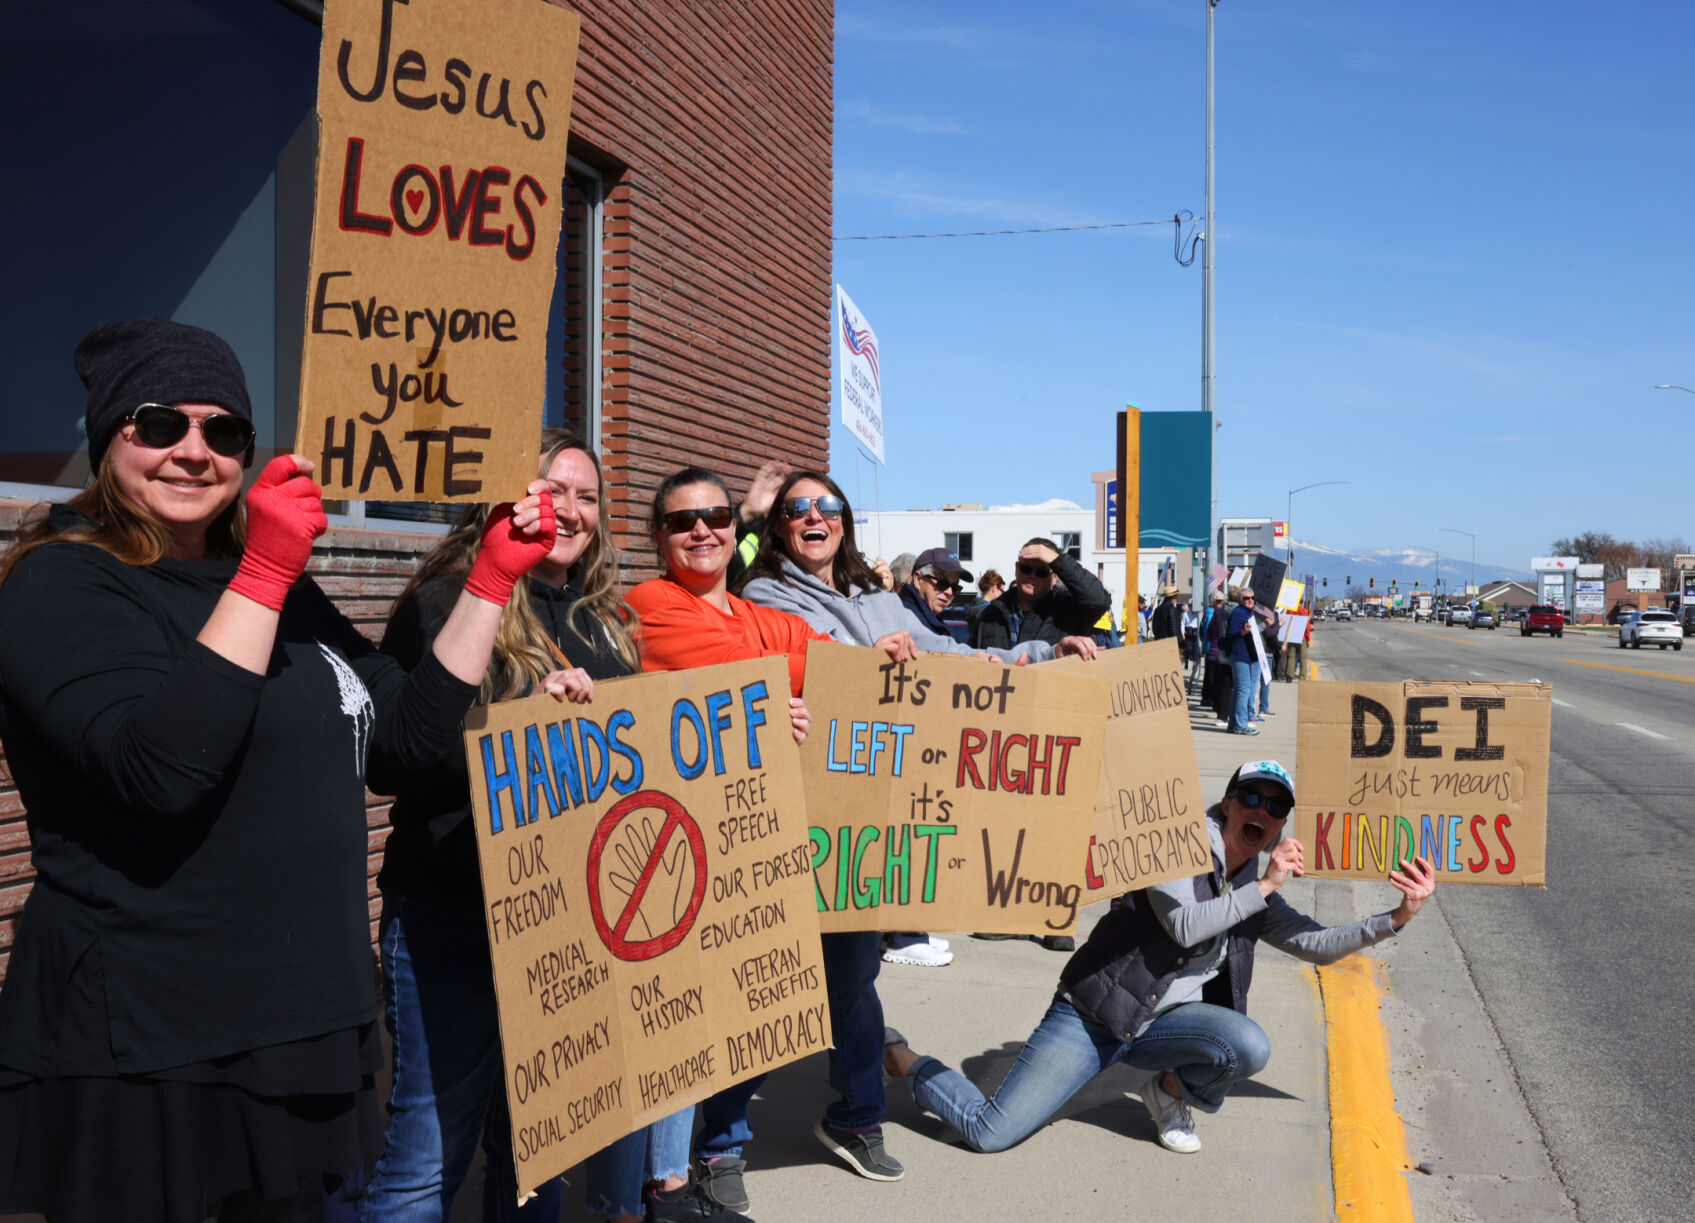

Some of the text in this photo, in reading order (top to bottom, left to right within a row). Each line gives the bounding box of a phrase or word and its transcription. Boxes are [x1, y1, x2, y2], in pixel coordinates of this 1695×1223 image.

[337, 0, 547, 141] Jesus
[339, 137, 547, 261] LOVES
[312, 271, 518, 369] Everyone
[360, 361, 464, 424] you
[321, 416, 491, 497] HATE
[879, 662, 1015, 714] It's not
[1108, 671, 1183, 719] LIONAIRES
[479, 680, 769, 835] HANDS OFF
[827, 719, 1081, 795] LEFT or RIGHT
[1351, 694, 1506, 761] DEI
[724, 773, 767, 812] FREE
[910, 783, 953, 823] it's
[1119, 778, 1187, 830] PUBLIC
[1349, 766, 1510, 806] just means
[508, 835, 549, 885] OUR
[718, 809, 780, 855] SPEECH
[1098, 821, 1207, 885] PROGRAMS
[1315, 812, 1516, 874] KINDNESS
[713, 845, 810, 903] OUR FORESTS
[808, 824, 957, 912] RIGHT
[948, 856, 966, 870] or
[982, 828, 1081, 930] Wrong
[491, 878, 568, 944] FREEDOM
[701, 899, 786, 950] EDUCATION
[526, 939, 593, 995] MEDICAL
[541, 961, 609, 1016] RESEARCH
[631, 975, 665, 1011] OUR
[732, 940, 801, 991] VETERAN
[747, 966, 819, 1012] BENEFITS
[641, 986, 704, 1037] HISTORY
[727, 1003, 825, 1076] DEMOCRACY
[515, 1016, 610, 1105] OUR PRIVACY
[639, 1045, 715, 1110] HEALTHCARE
[518, 1077, 623, 1162] SOCIAL SECURITY
